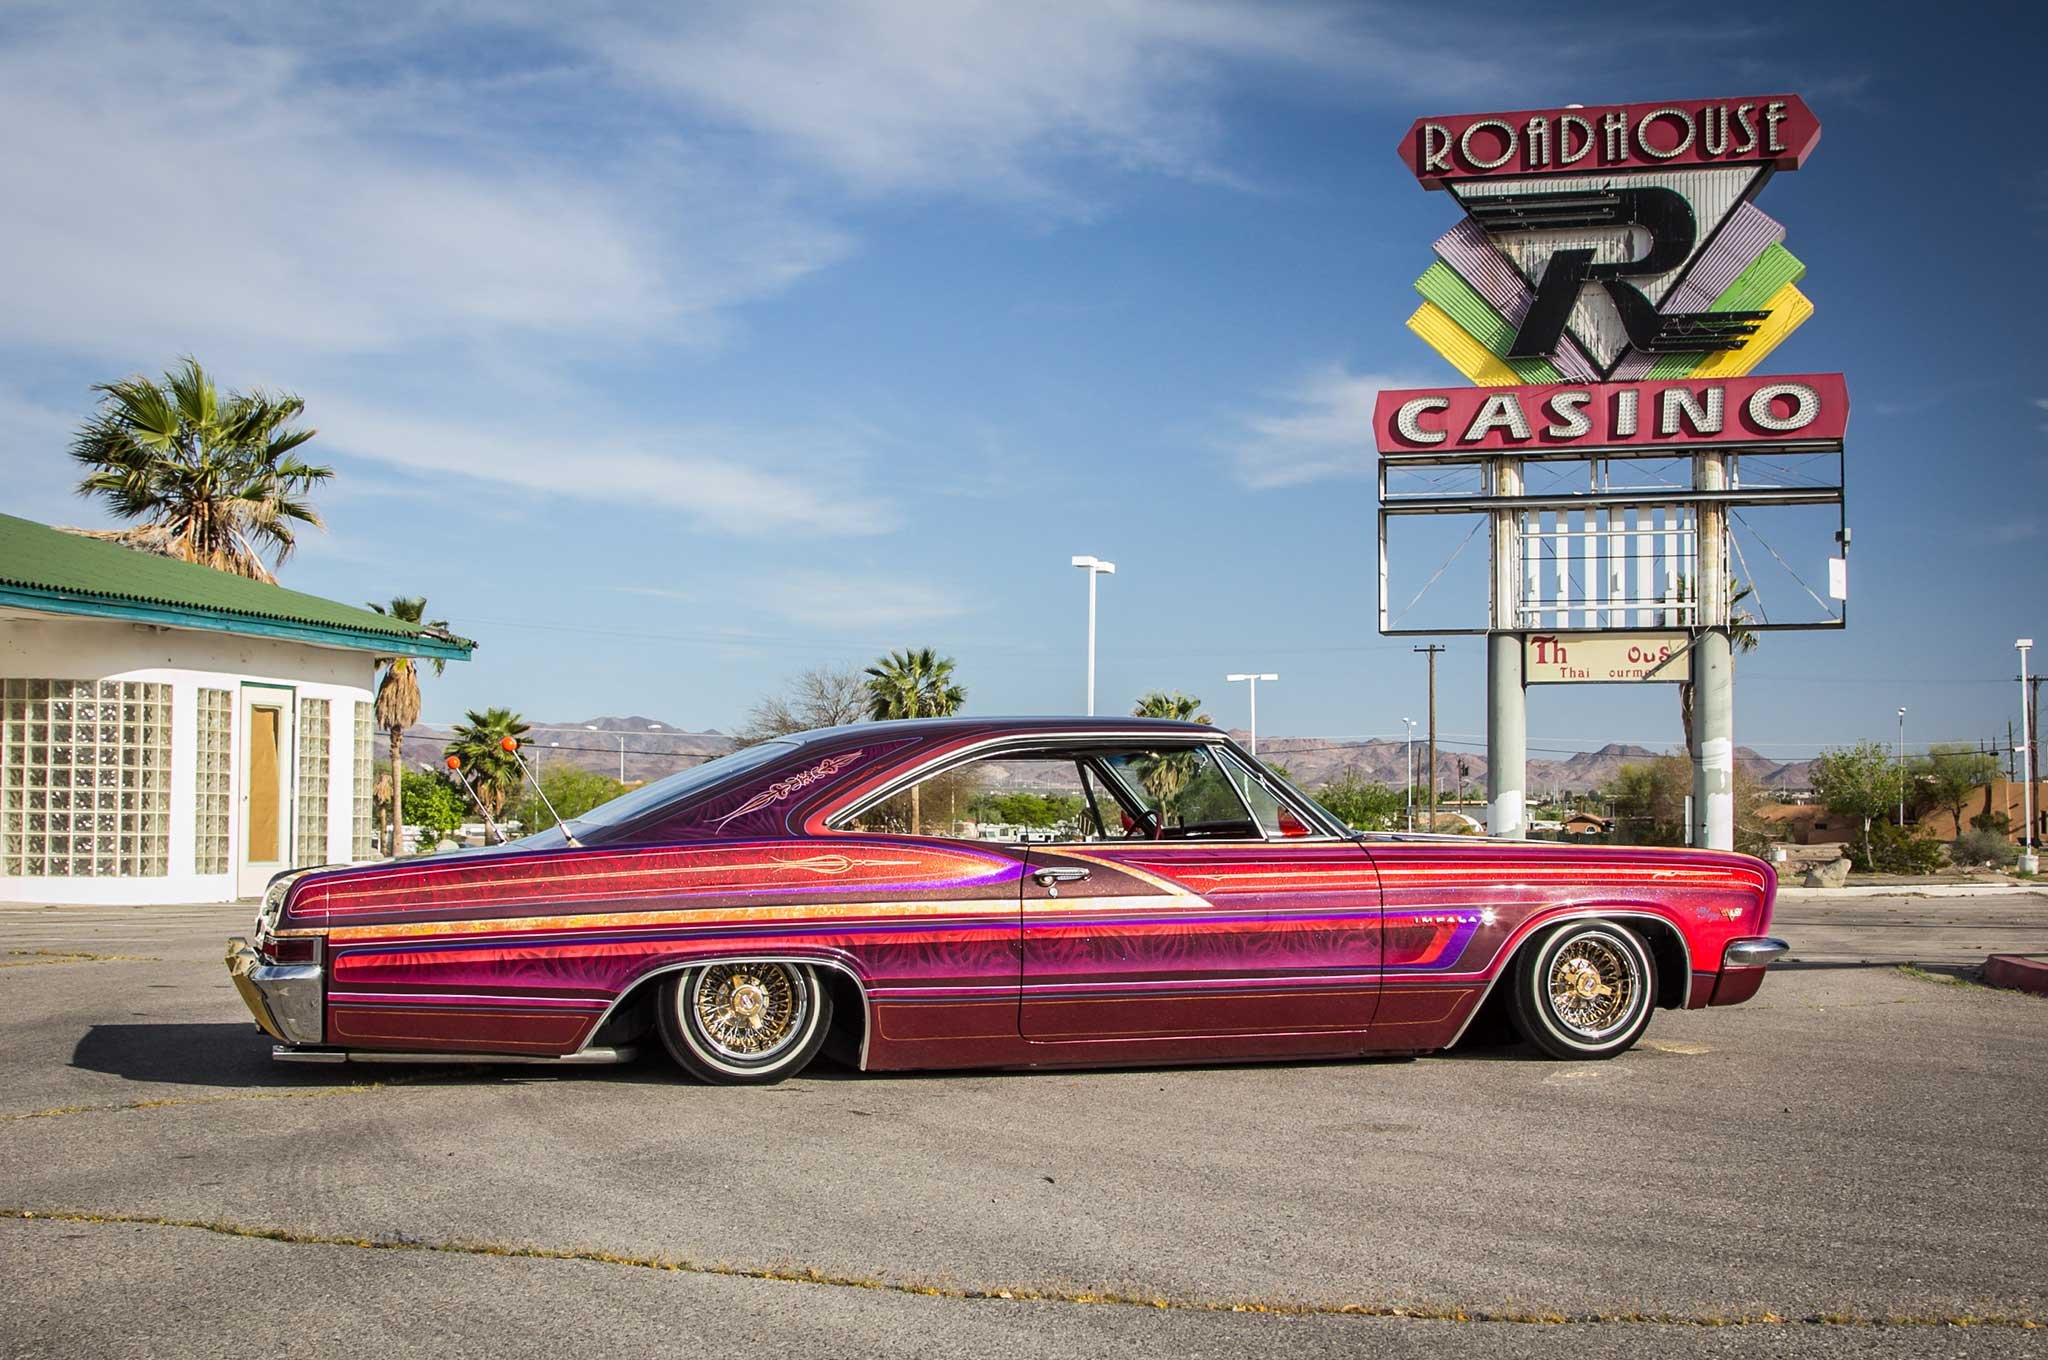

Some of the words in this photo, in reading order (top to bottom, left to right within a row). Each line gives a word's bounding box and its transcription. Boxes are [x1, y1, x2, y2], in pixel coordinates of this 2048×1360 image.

[1425, 101, 1787, 171] ROADHOUSE
[1458, 186, 1772, 358] R
[1398, 382, 1822, 444] CASINO
[1531, 635, 1567, 664] Th
[1560, 667, 1590, 678] Thai
[1414, 915, 1477, 923] IMPALA
